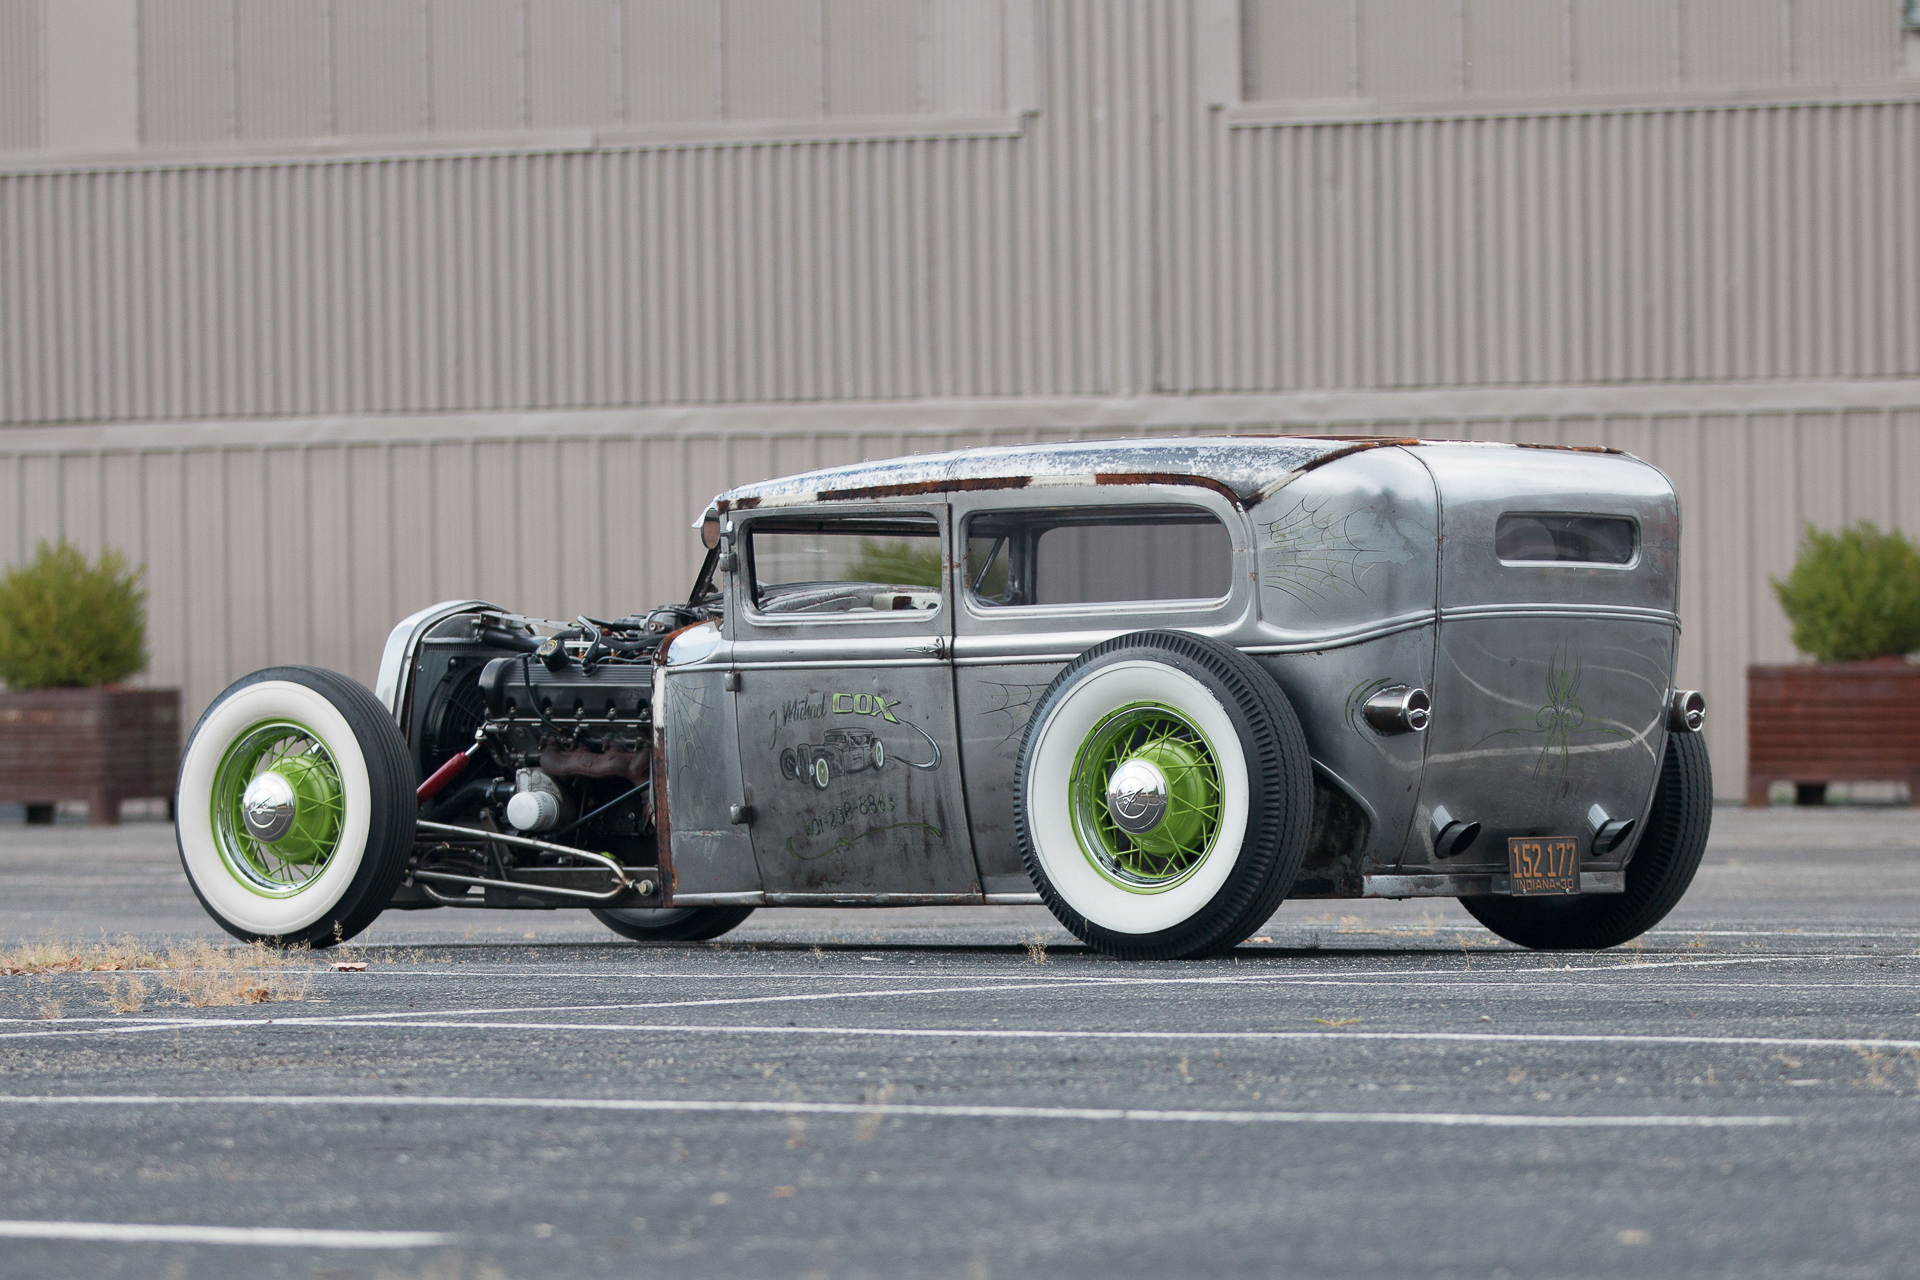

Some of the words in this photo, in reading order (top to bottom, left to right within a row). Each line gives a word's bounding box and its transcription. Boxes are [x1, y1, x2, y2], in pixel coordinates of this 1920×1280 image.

[782, 692, 827, 727] Michael
[832, 692, 902, 725] COX
[1513, 844, 1543, 878] 152
[1547, 843, 1576, 877] 177
